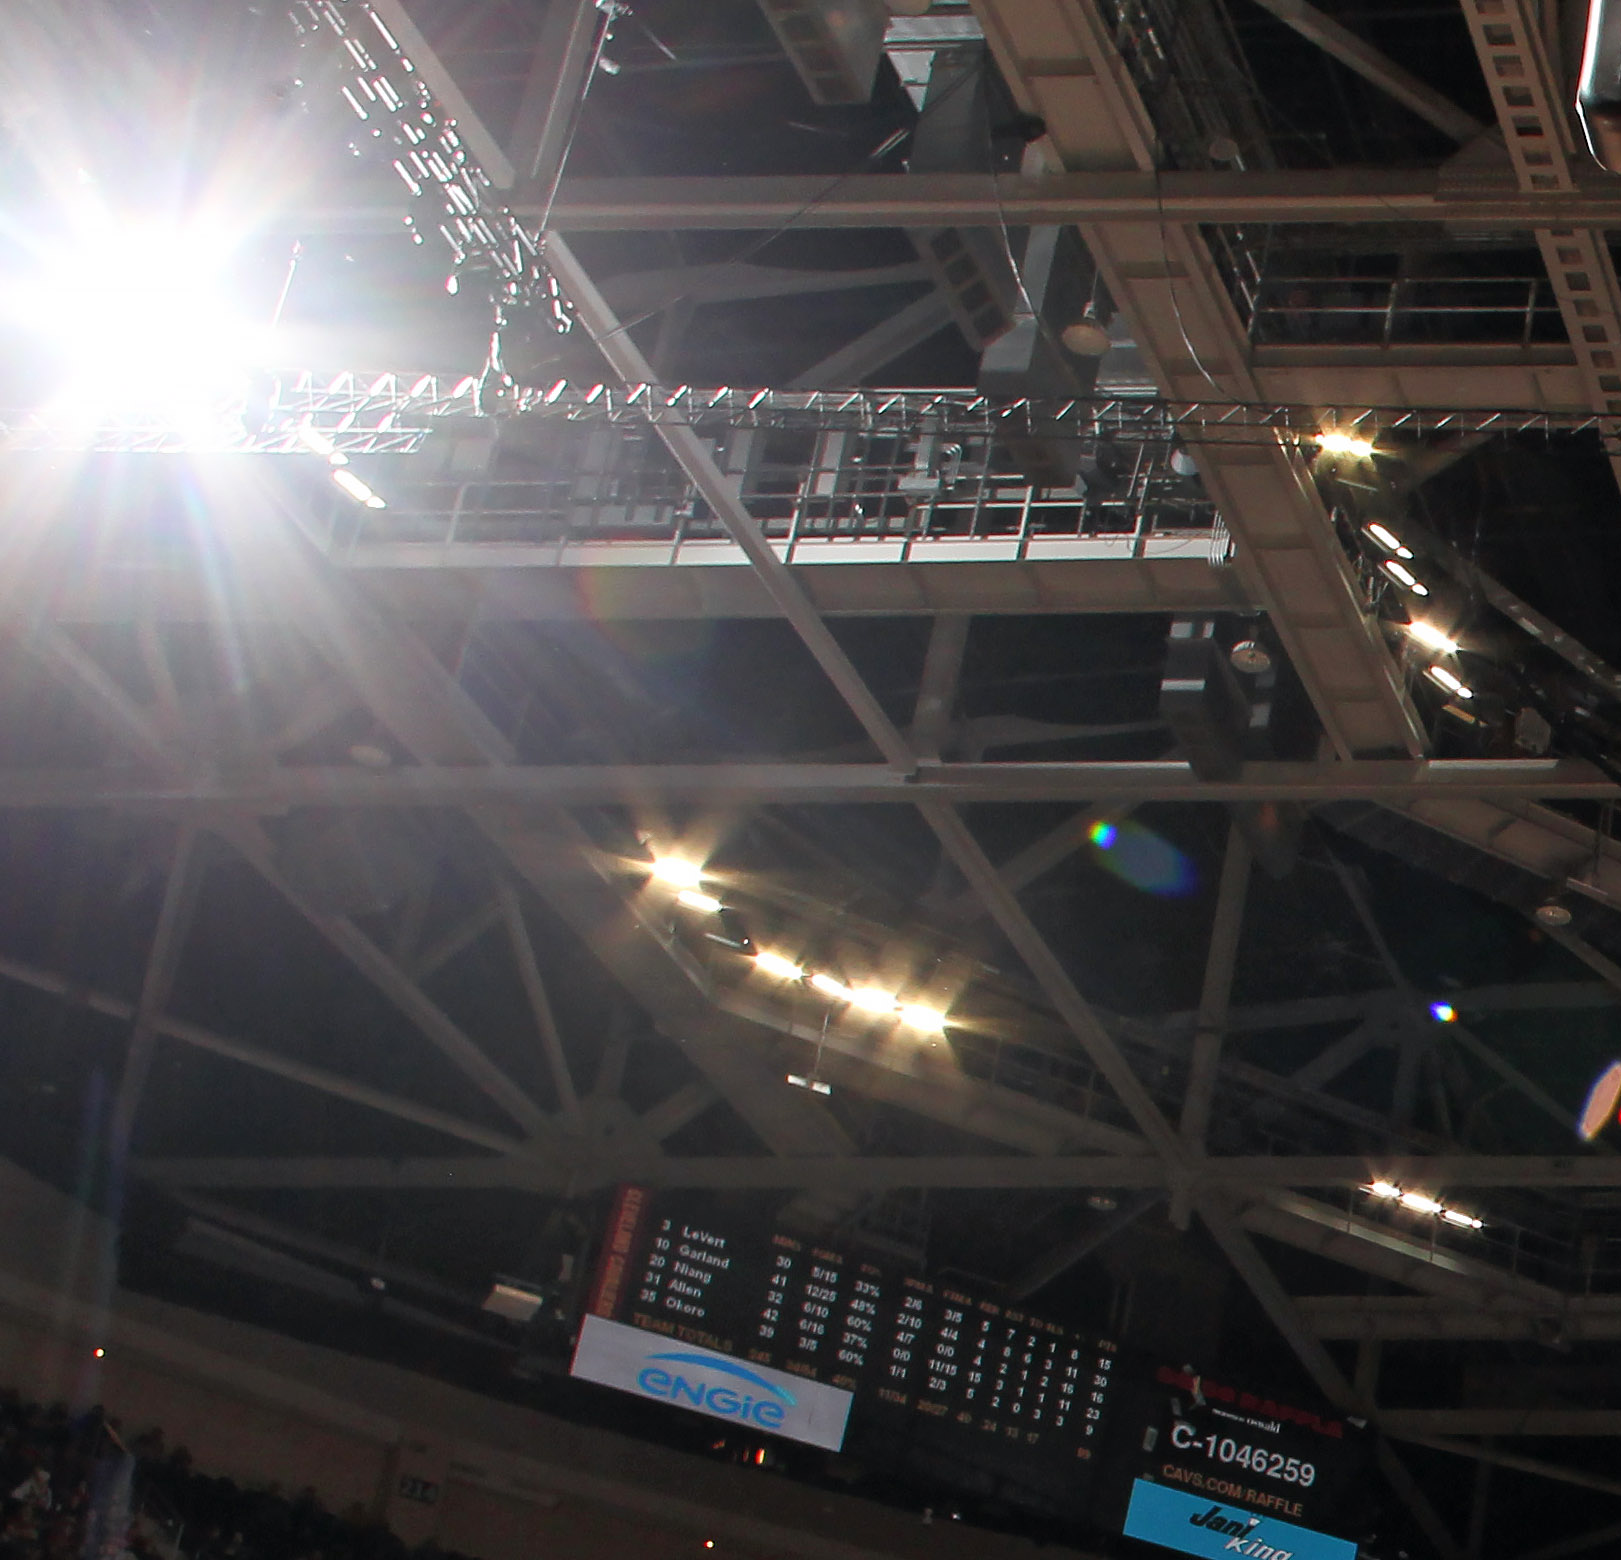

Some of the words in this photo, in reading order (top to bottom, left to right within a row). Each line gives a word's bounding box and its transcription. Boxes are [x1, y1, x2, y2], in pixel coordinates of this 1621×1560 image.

[682, 1225, 726, 1250] LeVert
[678, 1243, 731, 1270] Garland
[673, 1260, 713, 1285] Niang
[668, 1278, 702, 1298] Allen
[665, 1296, 706, 1318] Okoro
[1171, 1424, 1316, 1487] C-1046259
